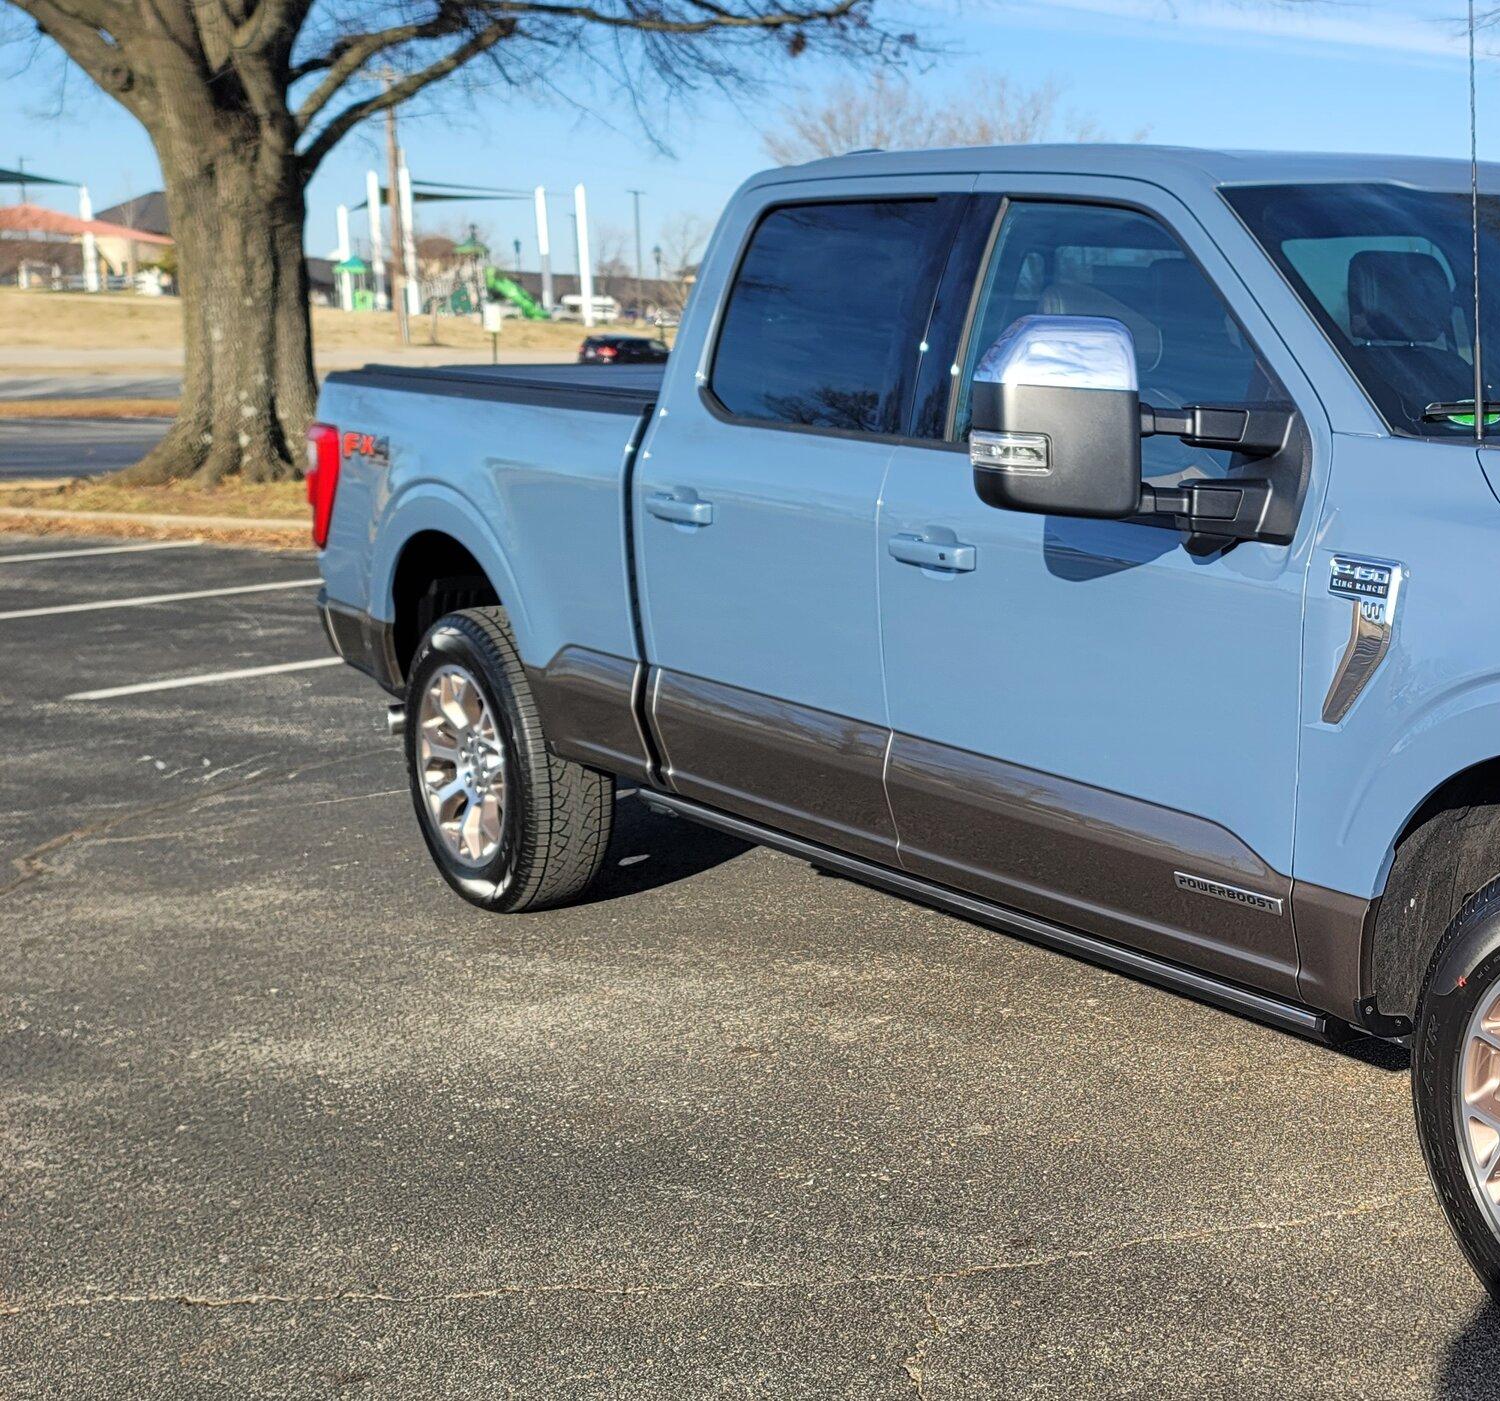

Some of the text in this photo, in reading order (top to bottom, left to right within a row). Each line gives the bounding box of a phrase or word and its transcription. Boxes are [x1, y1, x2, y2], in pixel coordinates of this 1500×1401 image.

[343, 431, 389, 460] FX4
[1332, 578, 1387, 595] KING RANCH
[1178, 875, 1275, 911] POWERBOOST
